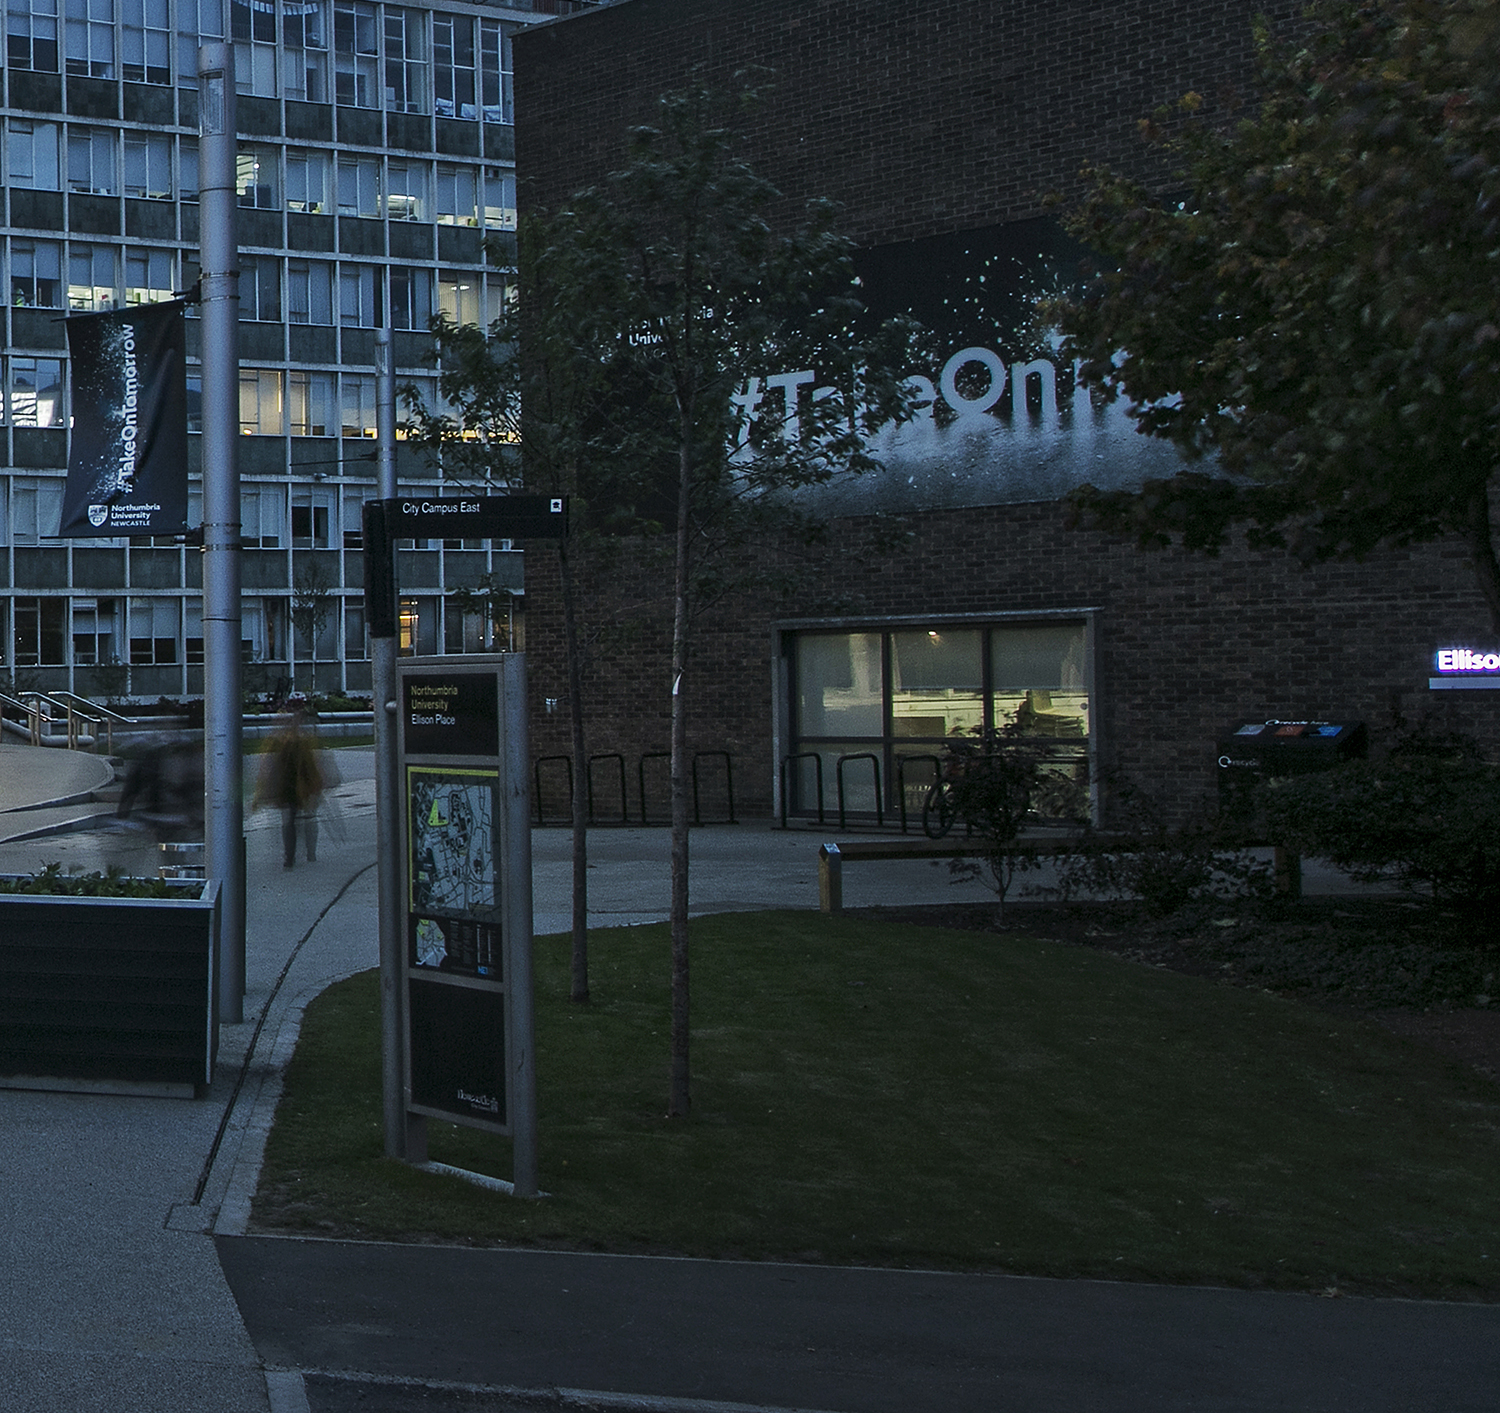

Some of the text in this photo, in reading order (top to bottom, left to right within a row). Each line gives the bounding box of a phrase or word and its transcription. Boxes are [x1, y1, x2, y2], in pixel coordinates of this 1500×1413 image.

[117, 323, 138, 494] #TakeOnTomorrow
[111, 503, 161, 511] Northumbria
[402, 501, 480, 516] City Campus East
[1438, 649, 1500, 670] Elliso
[411, 684, 458, 696] Northumbria
[411, 699, 449, 711] University
[411, 713, 456, 725] Ellison Place
